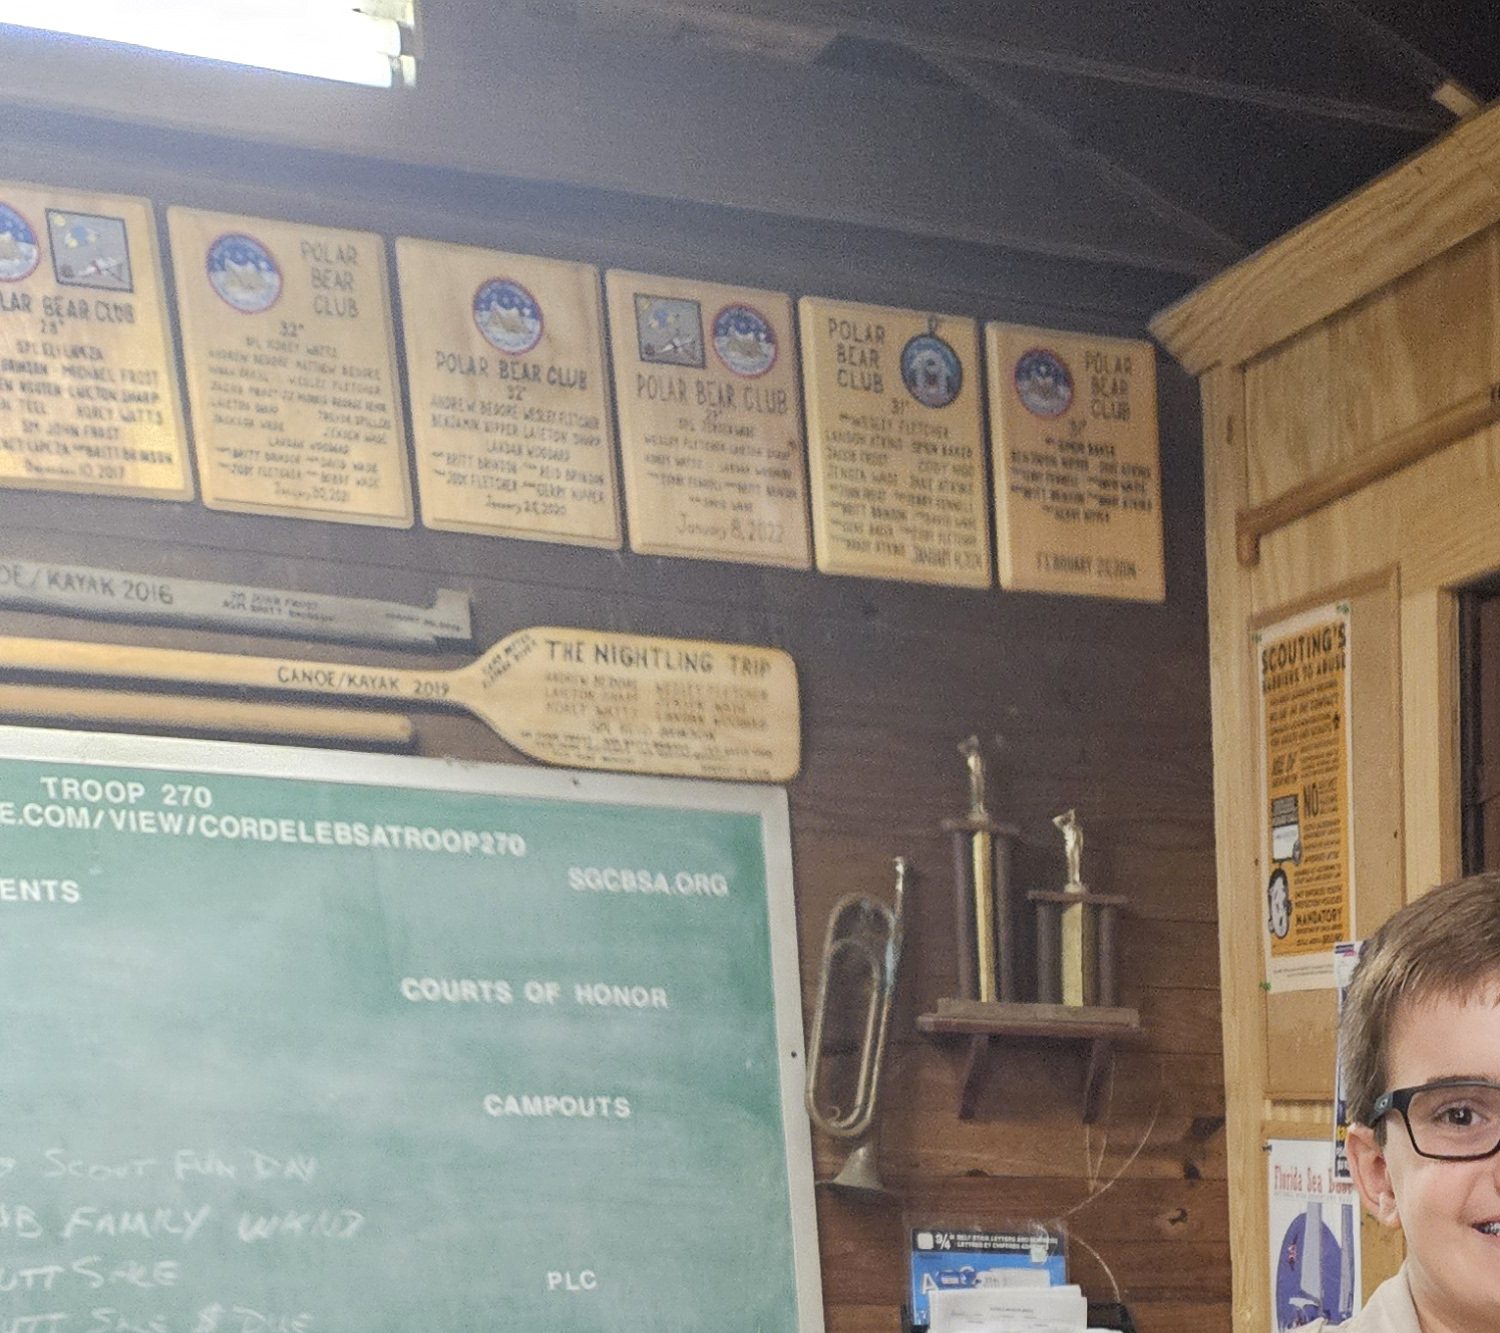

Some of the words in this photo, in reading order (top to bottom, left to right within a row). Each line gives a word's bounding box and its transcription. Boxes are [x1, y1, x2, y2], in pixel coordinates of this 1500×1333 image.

[300, 240, 359, 265] POLAR
[311, 267, 354, 291] BEAR
[43, 295, 89, 320] BEAR
[95, 300, 135, 324] CLUB
[312, 295, 360, 318] CLUB
[828, 317, 886, 345] POLAR
[837, 343, 880, 370] BEAR
[1085, 350, 1132, 375] POLAR
[436, 351, 489, 378] POLAR
[499, 359, 542, 383] BEAR
[547, 365, 588, 390] CLUB
[837, 368, 885, 394] CLUB
[637, 373, 688, 405] POLAR
[696, 378, 737, 409] BEAR
[744, 385, 787, 416] CLUB
[1091, 376, 1129, 397] BEAR
[1090, 400, 1130, 422] CLUB
[122, 579, 174, 605] 2016
[544, 639, 585, 663] THE
[594, 643, 714, 674] NIGHTLING
[728, 655, 771, 678] TRIP
[1262, 622, 1346, 675] SCOUTING'S
[277, 666, 400, 692] CANOE/KAYAK
[413, 679, 450, 695] 2019
[39, 776, 146, 804] TROOP
[160, 783, 214, 809] 270
[0, 877, 80, 904] ENTS
[567, 865, 730, 897] SGCBSA.ORG
[400, 976, 513, 1004] COURTS
[523, 979, 561, 1005] OF
[573, 981, 670, 1009] HONOR
[482, 1093, 632, 1119] CAMPOUTS
[1274, 1165, 1303, 1193] Florida
[1307, 1167, 1323, 1194] Sea
[62, 1203, 212, 1245] FAMILY
[547, 1270, 598, 1291] PLC
